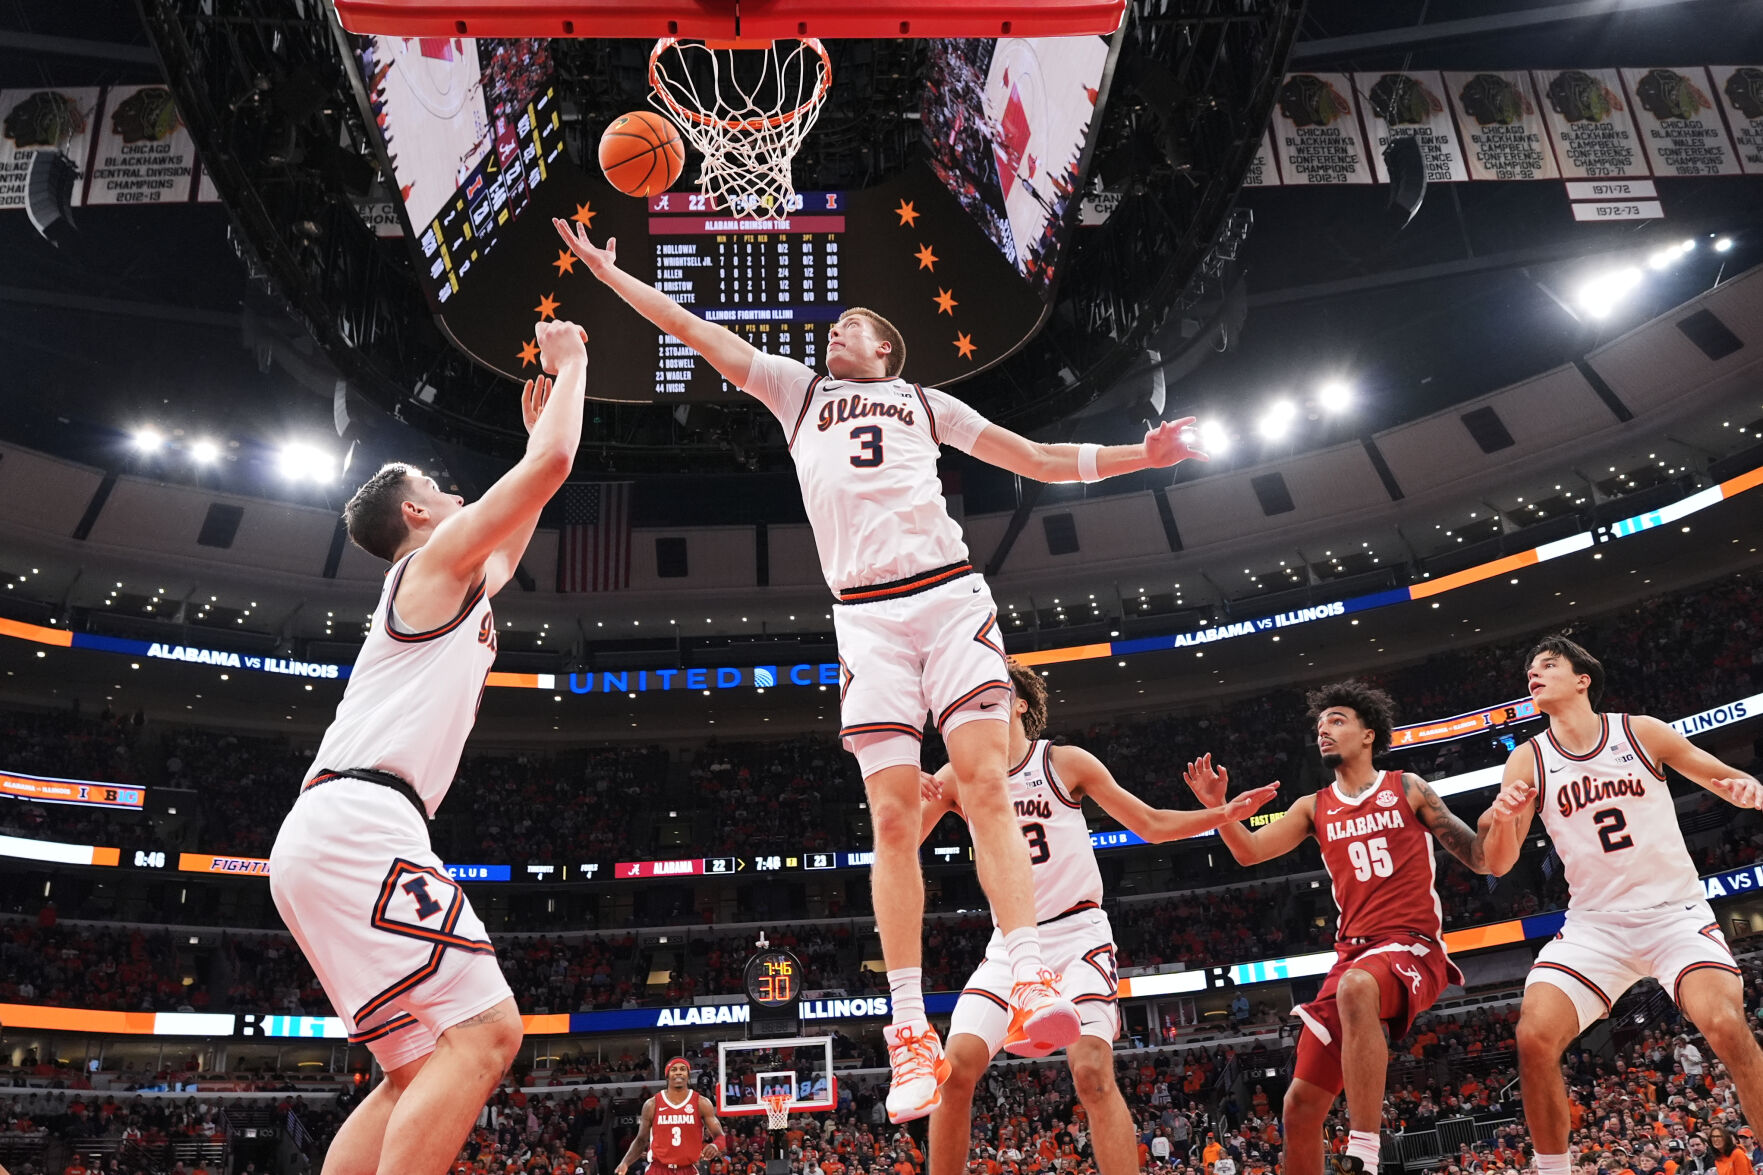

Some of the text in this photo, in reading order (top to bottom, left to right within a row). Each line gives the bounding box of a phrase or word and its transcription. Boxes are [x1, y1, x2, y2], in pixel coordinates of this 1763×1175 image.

[1296, 128, 1341, 137] CHICAGO
[1482, 126, 1524, 134] CHICAGO
[1571, 123, 1613, 132] CHICAGO
[1471, 134, 1539, 143] BLACKHAWKS
[1561, 131, 1629, 140] BLACKHAWKS
[1651, 129, 1718, 138] BLACKHAWKS
[1285, 137, 1355, 146] BLACKHAWKS
[1569, 140, 1625, 149] CAMPBELL
[121, 144, 171, 155] CHICAGO
[1296, 146, 1348, 155] WESTERN
[1480, 143, 1536, 152] CAMPBELL
[1658, 146, 1724, 156] CONFERENCE
[1476, 152, 1544, 161] CONFERENCE
[1566, 148, 1634, 158] CONFERENCE
[104, 155, 183, 167] BLACKHAWKS
[1289, 155, 1359, 165] CONFERENCE
[1484, 160, 1542, 170] CHAMPIONS
[1573, 157, 1632, 167] CHAMPIONS
[1665, 156, 1724, 165] CHAMPIONS
[93, 167, 191, 179] CENTRAL DIVISION
[1296, 164, 1356, 173] CHAMPIONS
[1586, 167, 1626, 176] 1970-71
[1308, 174, 1348, 183] 2012-13
[1496, 170, 1534, 179] 1991-92
[107, 179, 174, 190] CHAMPIONS
[1592, 184, 1631, 194] 1971-72
[116, 191, 161, 202] 2012-13
[688, 195, 705, 210] 22
[1596, 206, 1640, 216] 1972-73
[704, 220, 790, 230] ALABAMA CRIMSON TIDE
[662, 245, 697, 254] HOLLOWAY
[663, 257, 702, 267] WRIGHTSELL
[702, 256, 713, 266] JR.
[663, 269, 683, 279] ALLEN
[663, 281, 693, 291] BRISTOW
[720, 281, 725, 290] 4
[705, 309, 793, 320] ILLINOIS FIGHTING ILLINI
[779, 333, 790, 342] 3/3
[659, 359, 664, 368] 4
[665, 359, 695, 368] BOSWELL
[655, 371, 691, 380] 23 WAGLER
[655, 383, 664, 392] 44
[666, 383, 685, 392] IVISIC
[817, 394, 915, 432] Illinois
[850, 424, 884, 468] 3
[1174, 601, 1345, 647] ALABAMA VS ILLINOIS
[147, 643, 338, 678] ALABAMA VS ILLINOIS
[569, 667, 743, 694] UNITED
[1557, 772, 1645, 817] Illinois
[1250, 814, 1268, 827] FAST
[1326, 809, 1405, 842] ALABAMA
[1592, 807, 1635, 853] 2
[1348, 836, 1394, 882] 95
[653, 860, 693, 875] ALABAMA
[712, 859, 726, 871] 22
[813, 855, 827, 867] 23
[448, 868, 488, 878] CLUB
[1727, 872, 1752, 890] VS
[401, 875, 443, 922] I
[763, 961, 792, 976] 7:46
[758, 976, 790, 1001] 30
[799, 998, 888, 1019] ILLINOIS
[657, 1115, 695, 1125] ALABAMA
[671, 1126, 682, 1147] 3
